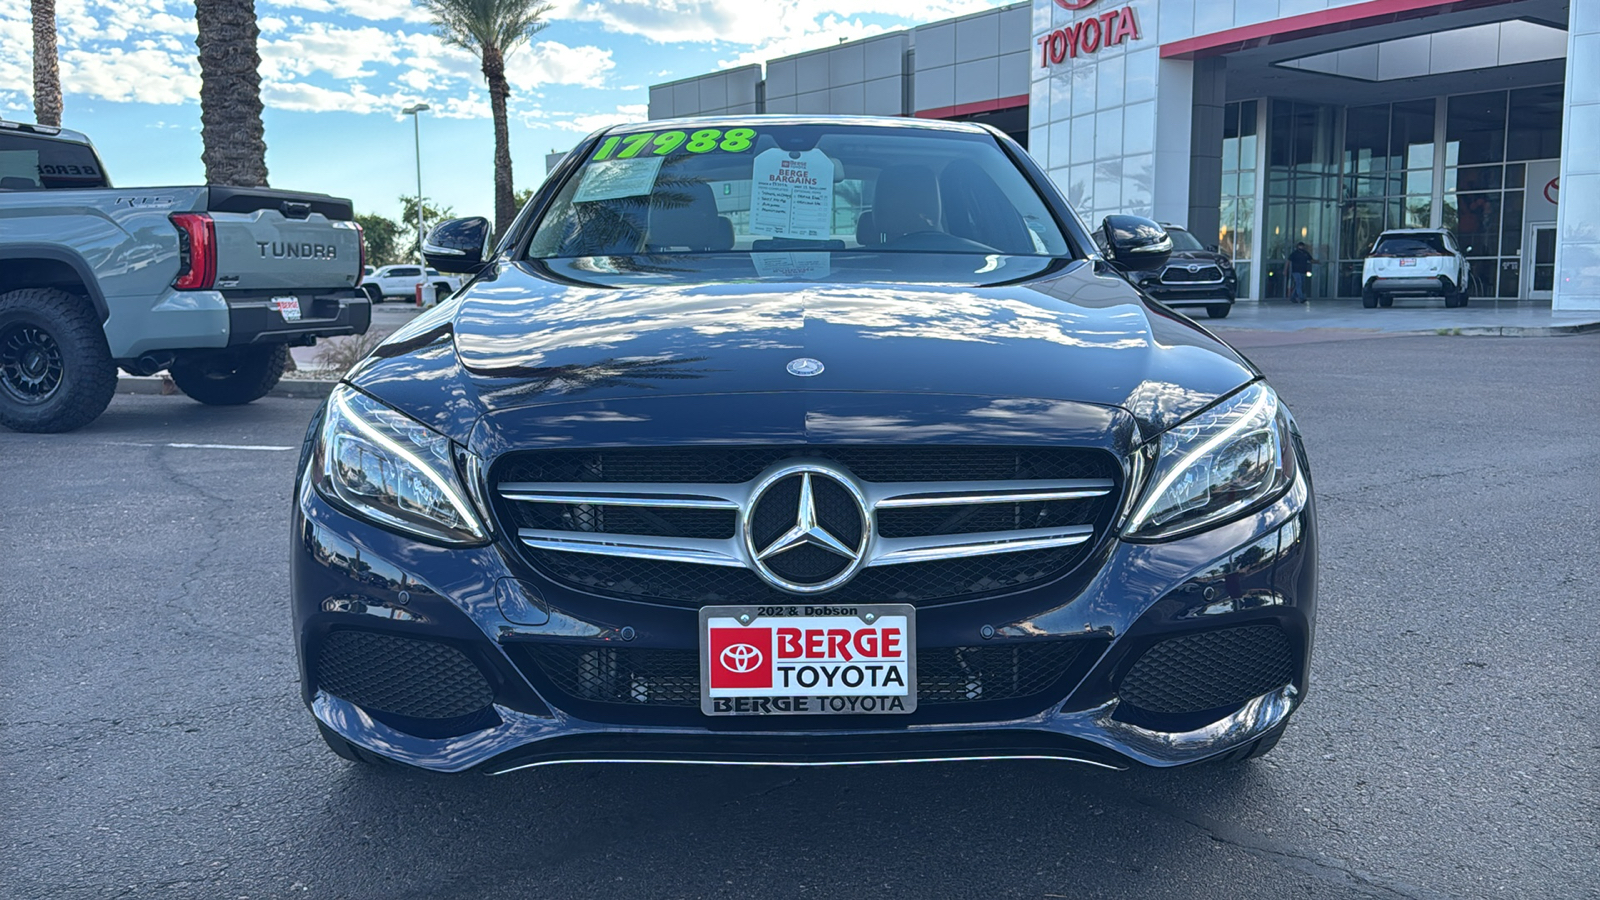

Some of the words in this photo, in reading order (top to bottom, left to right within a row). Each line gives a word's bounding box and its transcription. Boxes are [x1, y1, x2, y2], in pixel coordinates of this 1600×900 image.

[1037, 6, 1138, 68] TOYOTA
[592, 128, 757, 161] 17988
[769, 174, 818, 185] BARGAINS
[779, 169, 809, 178] BERGE
[256, 241, 337, 260] TUNDRA
[757, 606, 784, 616] 202
[788, 606, 800, 616] &
[804, 606, 858, 616] Dobson
[776, 628, 902, 662] BERGE
[777, 665, 905, 688] TOYOTA
[713, 696, 809, 713] BERGE
[816, 696, 905, 711] TOYOTA
